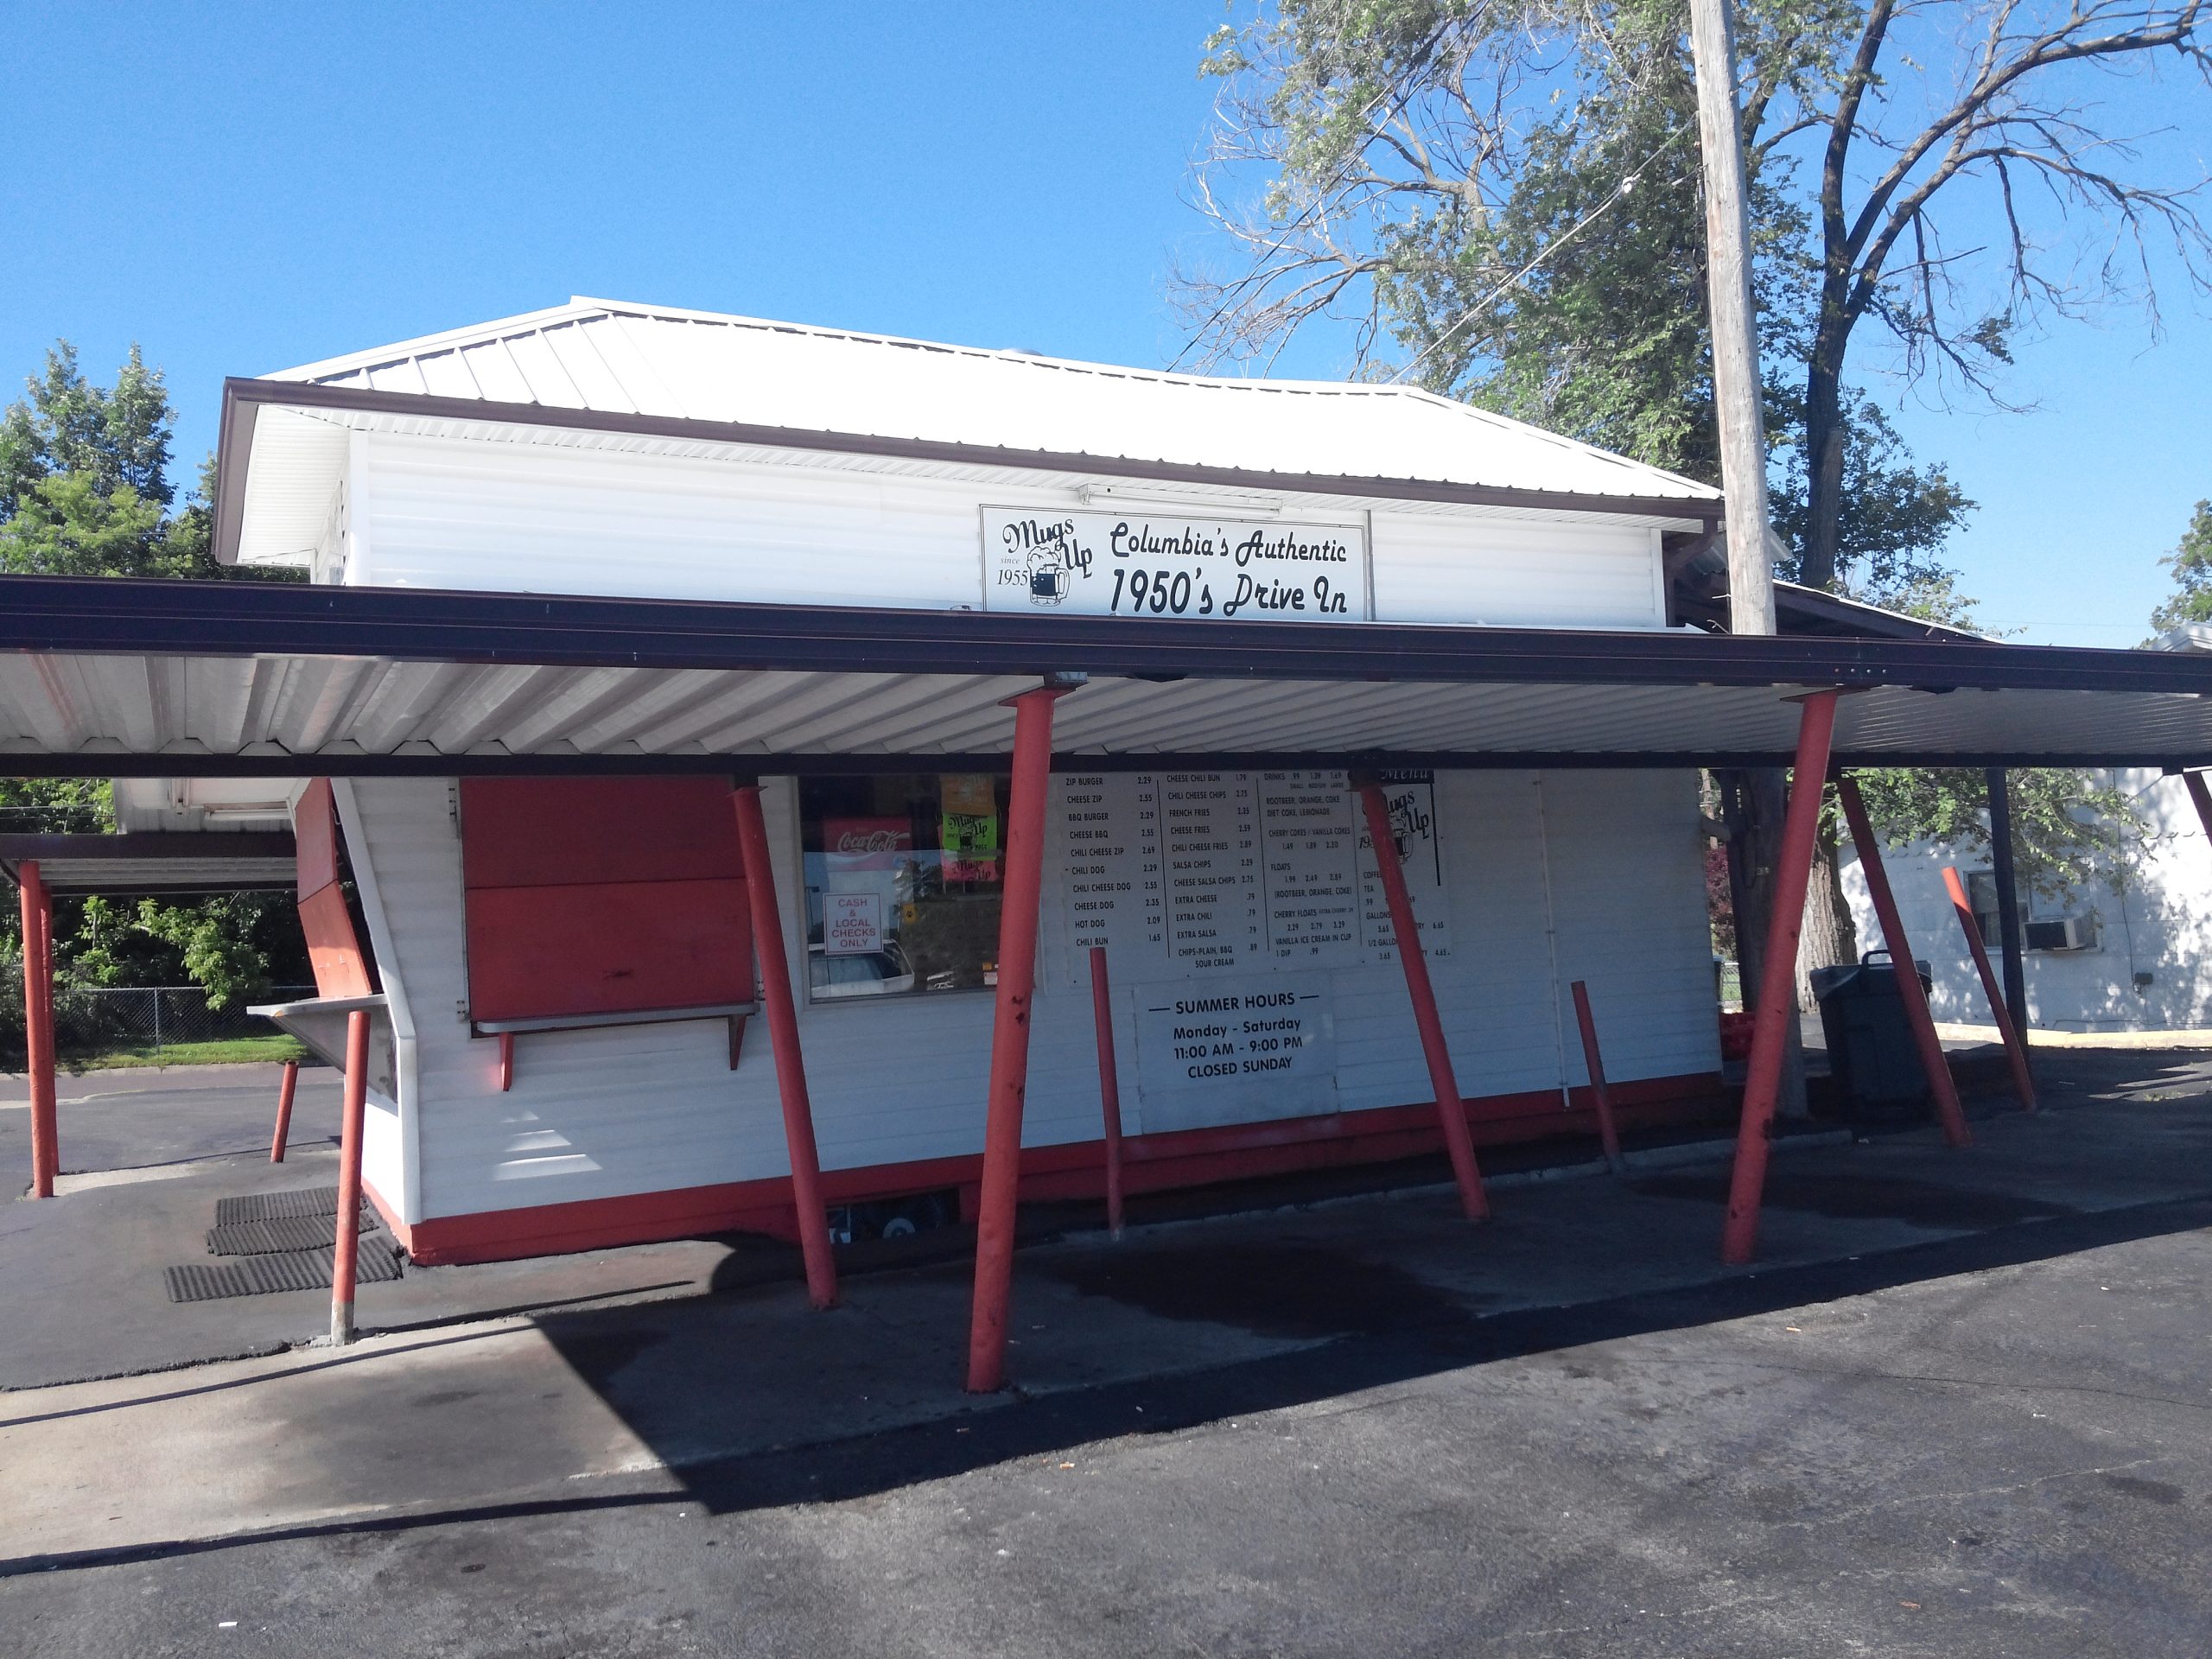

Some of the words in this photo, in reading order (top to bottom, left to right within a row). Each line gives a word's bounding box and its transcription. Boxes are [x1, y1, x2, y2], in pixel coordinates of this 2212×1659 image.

[1002, 518, 1075, 554] Mugs
[1109, 522, 1229, 558] Columbia's
[1235, 530, 1347, 567] Authentic
[1001, 556, 1020, 565] since
[1059, 537, 1093, 579] Up
[997, 569, 1029, 587] 1955
[1110, 567, 1212, 614] 1950's
[1223, 573, 1305, 617] Drive
[1313, 575, 1347, 613] In
[1166, 774, 1189, 783] CHEESE
[1067, 795, 1090, 804] CHEESE
[1168, 791, 1183, 800] CHILI
[1084, 812, 1109, 821] BURGER
[1408, 808, 1429, 839] Up
[1070, 830, 1092, 839] CHEESE
[1170, 826, 1192, 835] CHEESE
[1071, 849, 1087, 857] CHILI
[1089, 848, 1112, 856] CHEESE
[1114, 847, 1124, 855] ZIP
[1270, 862, 1291, 871] FLOATS
[1174, 878, 1196, 887] CHEESE
[1198, 877, 1217, 886] SALSA
[1217, 876, 1236, 885] CHIPS
[1091, 883, 1115, 892] CHEESE
[1116, 882, 1131, 891] DOG
[838, 899, 868, 907] CASH
[1175, 896, 1194, 905] EXTRA
[1196, 894, 1217, 903] CHEESE
[1074, 902, 1097, 911] CHEESE
[1099, 900, 1115, 909] DOG
[1176, 913, 1195, 922] EXTRA
[1298, 908, 1318, 917] FLOATS
[836, 918, 871, 928] LOCAL
[1075, 920, 1088, 929] HOT
[1147, 916, 1160, 925] 2.09
[831, 928, 876, 938] CHECKS
[1177, 931, 1196, 939] EXTRA
[1198, 929, 1217, 938] SALSA
[840, 938, 868, 948] ONLY
[1095, 937, 1109, 945] BUN
[1148, 933, 1160, 942] 1.65
[1274, 937, 1298, 945] VANILLA
[1220, 945, 1232, 954] BBQ
[1213, 958, 1235, 967] CREAM
[1175, 997, 1239, 1014] SUMMER
[1245, 993, 1295, 1008] HOURS
[1173, 1024, 1227, 1039] Monday
[1243, 1017, 1301, 1033] Saturday
[1174, 1046, 1207, 1059] 11:00
[1212, 1043, 1234, 1057] AM
[1249, 1038, 1278, 1052] 9:00
[1284, 1036, 1303, 1049] PM
[1187, 1062, 1237, 1078] CLOSED
[1243, 1057, 1293, 1073] SUNDAY
